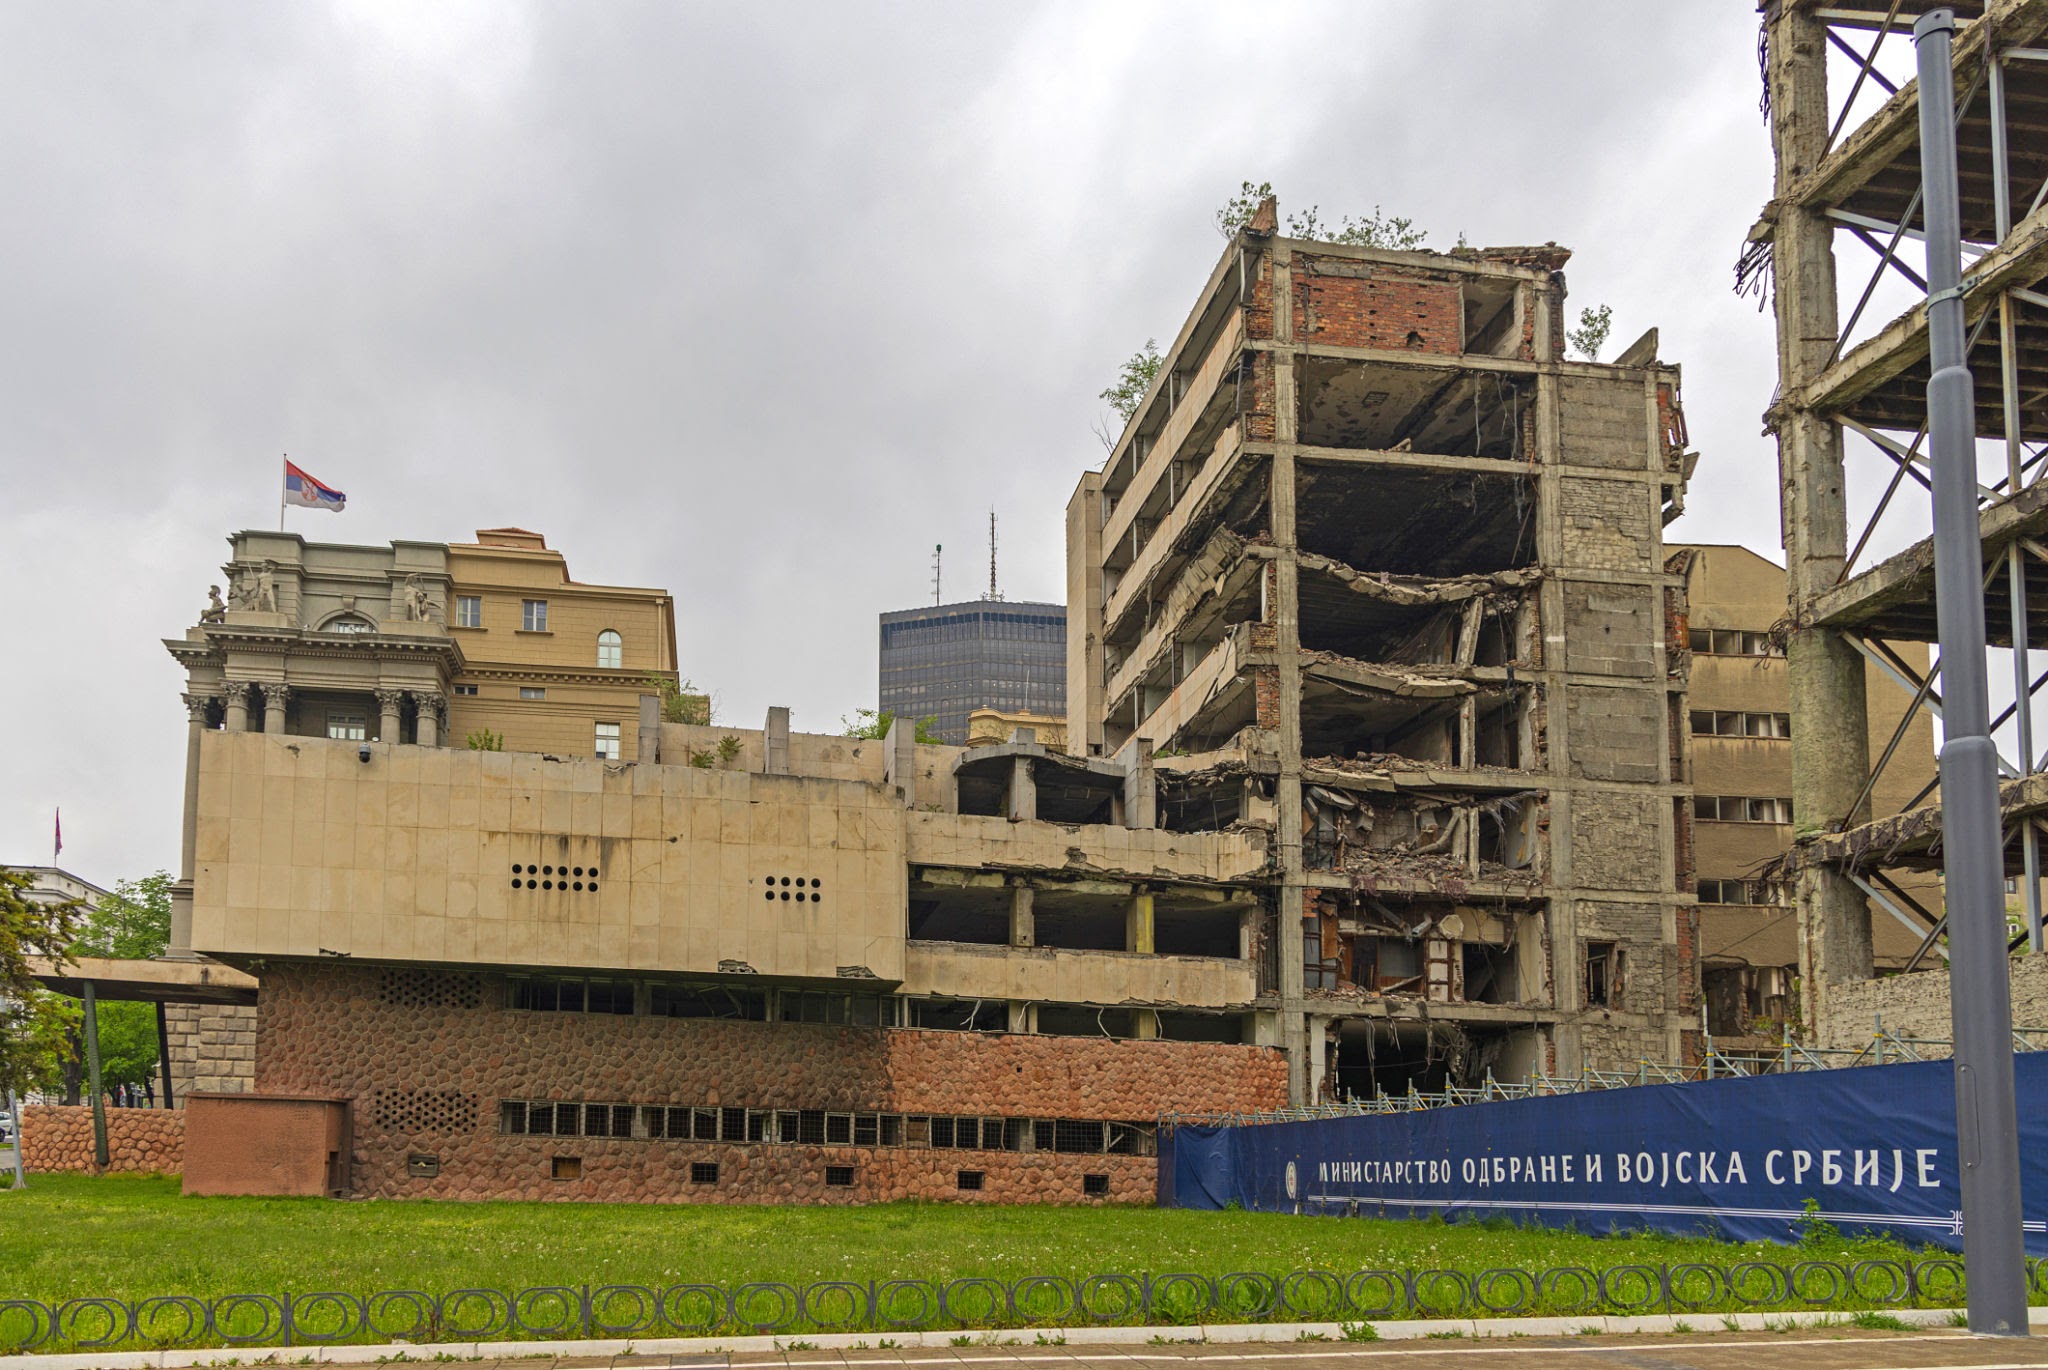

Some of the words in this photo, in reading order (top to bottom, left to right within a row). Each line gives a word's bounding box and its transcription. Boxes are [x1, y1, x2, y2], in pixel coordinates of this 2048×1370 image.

[1319, 1159, 1450, 1185] МИНИСТАРСТВО
[1462, 1155, 1575, 1187] ОДБРАНЕ
[1585, 1153, 1603, 1183] И
[1617, 1151, 1747, 1188] ВОЈСКА
[1765, 1149, 1941, 1193] СРБИЈЕ
